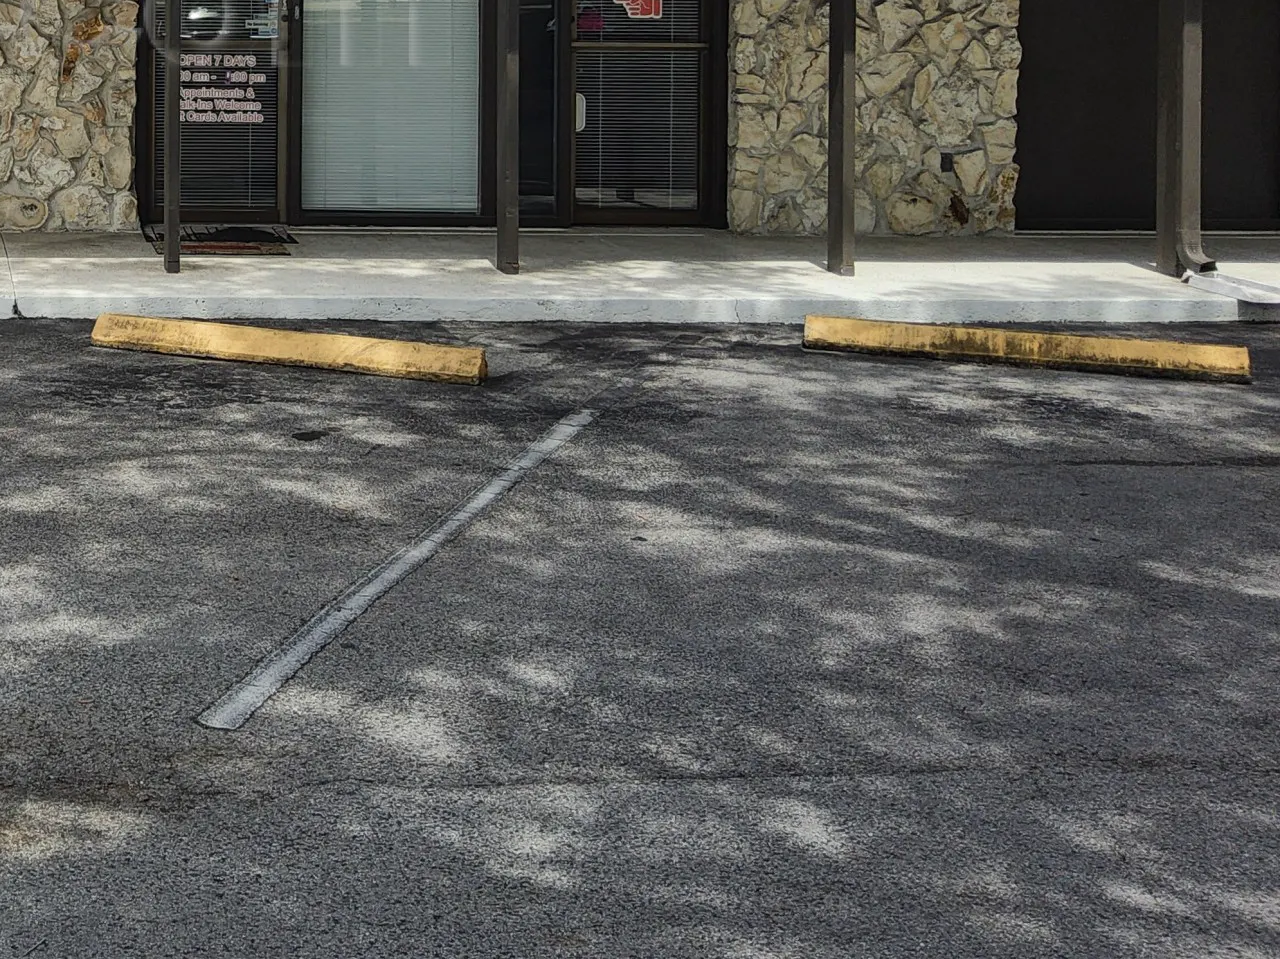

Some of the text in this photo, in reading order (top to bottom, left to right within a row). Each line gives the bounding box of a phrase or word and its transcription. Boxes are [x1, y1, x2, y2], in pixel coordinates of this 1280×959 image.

[180, 54, 257, 67] OPEN 7 DAYS
[192, 72, 210, 82] am
[248, 73, 267, 85] pm
[245, 87, 256, 99] &
[180, 99, 262, 110] alk-Ins Welcome
[186, 110, 217, 122] Cards
[217, 110, 264, 123] Available
